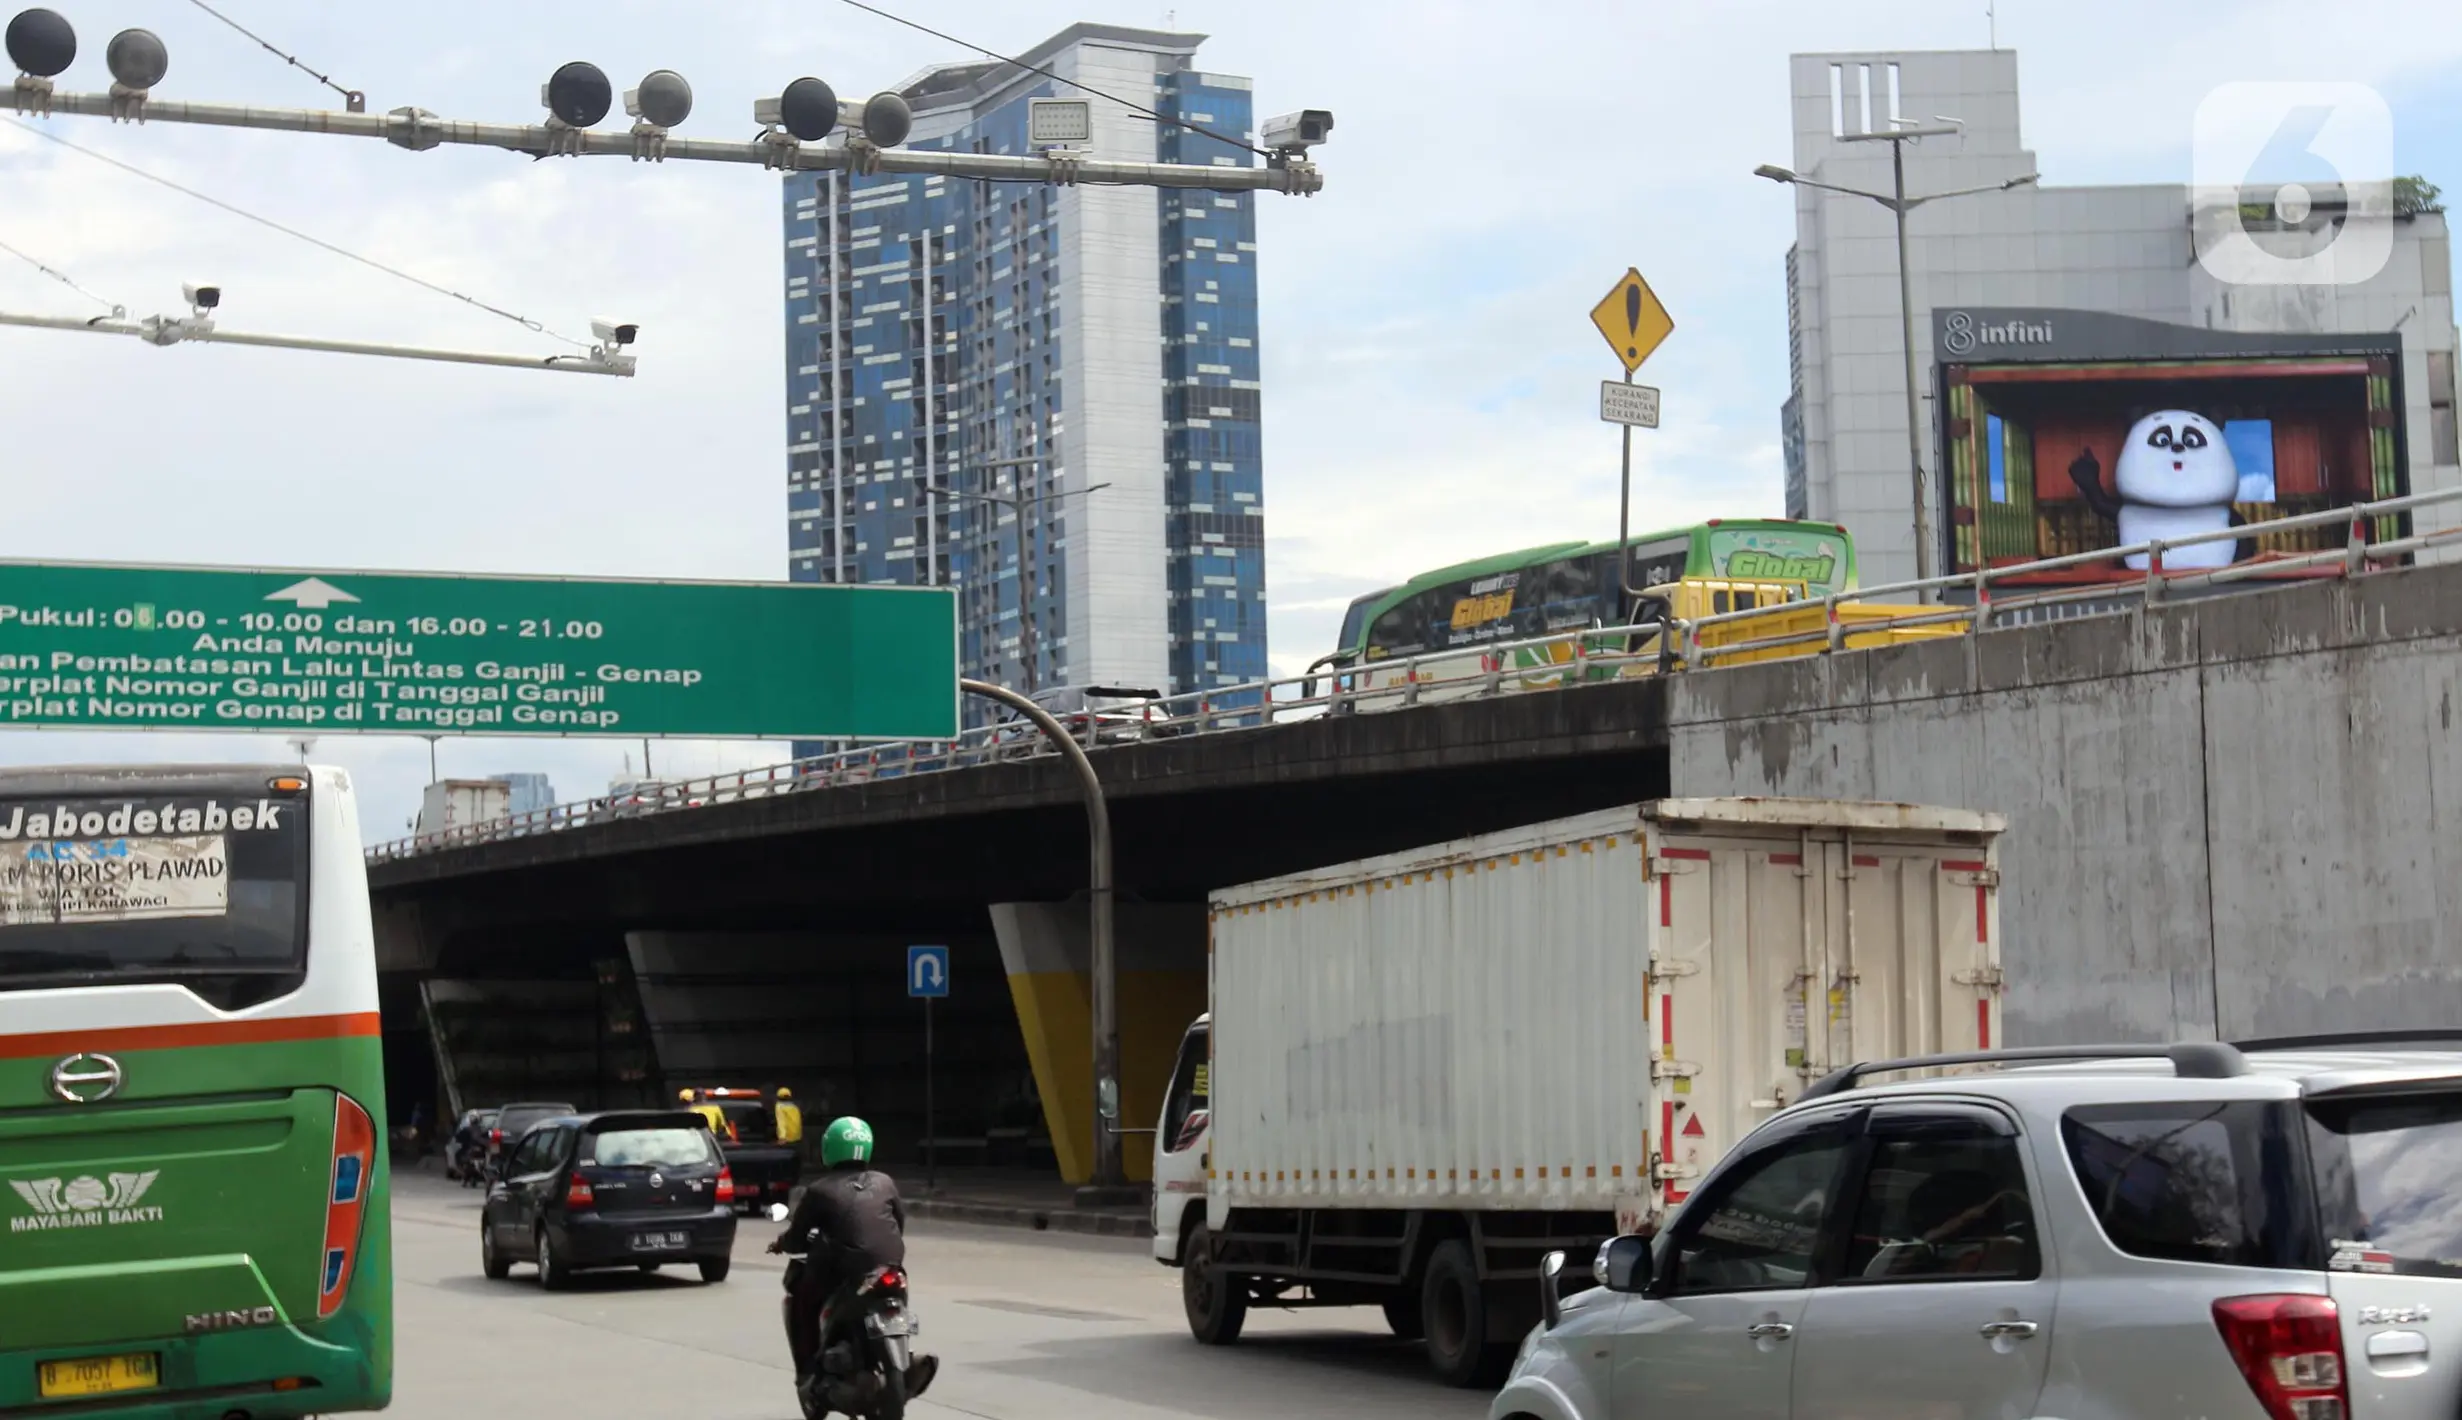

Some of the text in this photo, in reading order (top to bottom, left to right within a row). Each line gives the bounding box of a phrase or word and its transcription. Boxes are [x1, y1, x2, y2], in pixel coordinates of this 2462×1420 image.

[1980, 320, 2053, 344] infini
[1727, 550, 1835, 584] Global
[239, 612, 323, 632] 10.00
[334, 615, 396, 634] dan
[406, 616, 487, 636] 16.00
[519, 618, 603, 638] 21.00
[192, 632, 413, 659] Anda Menuju
[51, 651, 272, 675] Pembatasan
[283, 657, 353, 677] Lalu
[361, 658, 464, 679] Lintas
[475, 661, 565, 684] Ganjil
[597, 664, 702, 686] Genap
[106, 675, 223, 696] Nomor
[232, 678, 328, 702] Ganjil
[335, 681, 365, 699] di
[374, 681, 508, 704] Tanggal
[516, 684, 605, 707] Ganjil
[88, 697, 206, 718] Nomor
[216, 700, 326, 724] Genap
[333, 703, 363, 721] di
[372, 703, 502, 726] Tanggal
[512, 705, 620, 728] Genap
[0, 799, 280, 839] Jabodetabek
[11, 1206, 163, 1232] MAYASARI BAKTI
[186, 1306, 275, 1330] HINO
